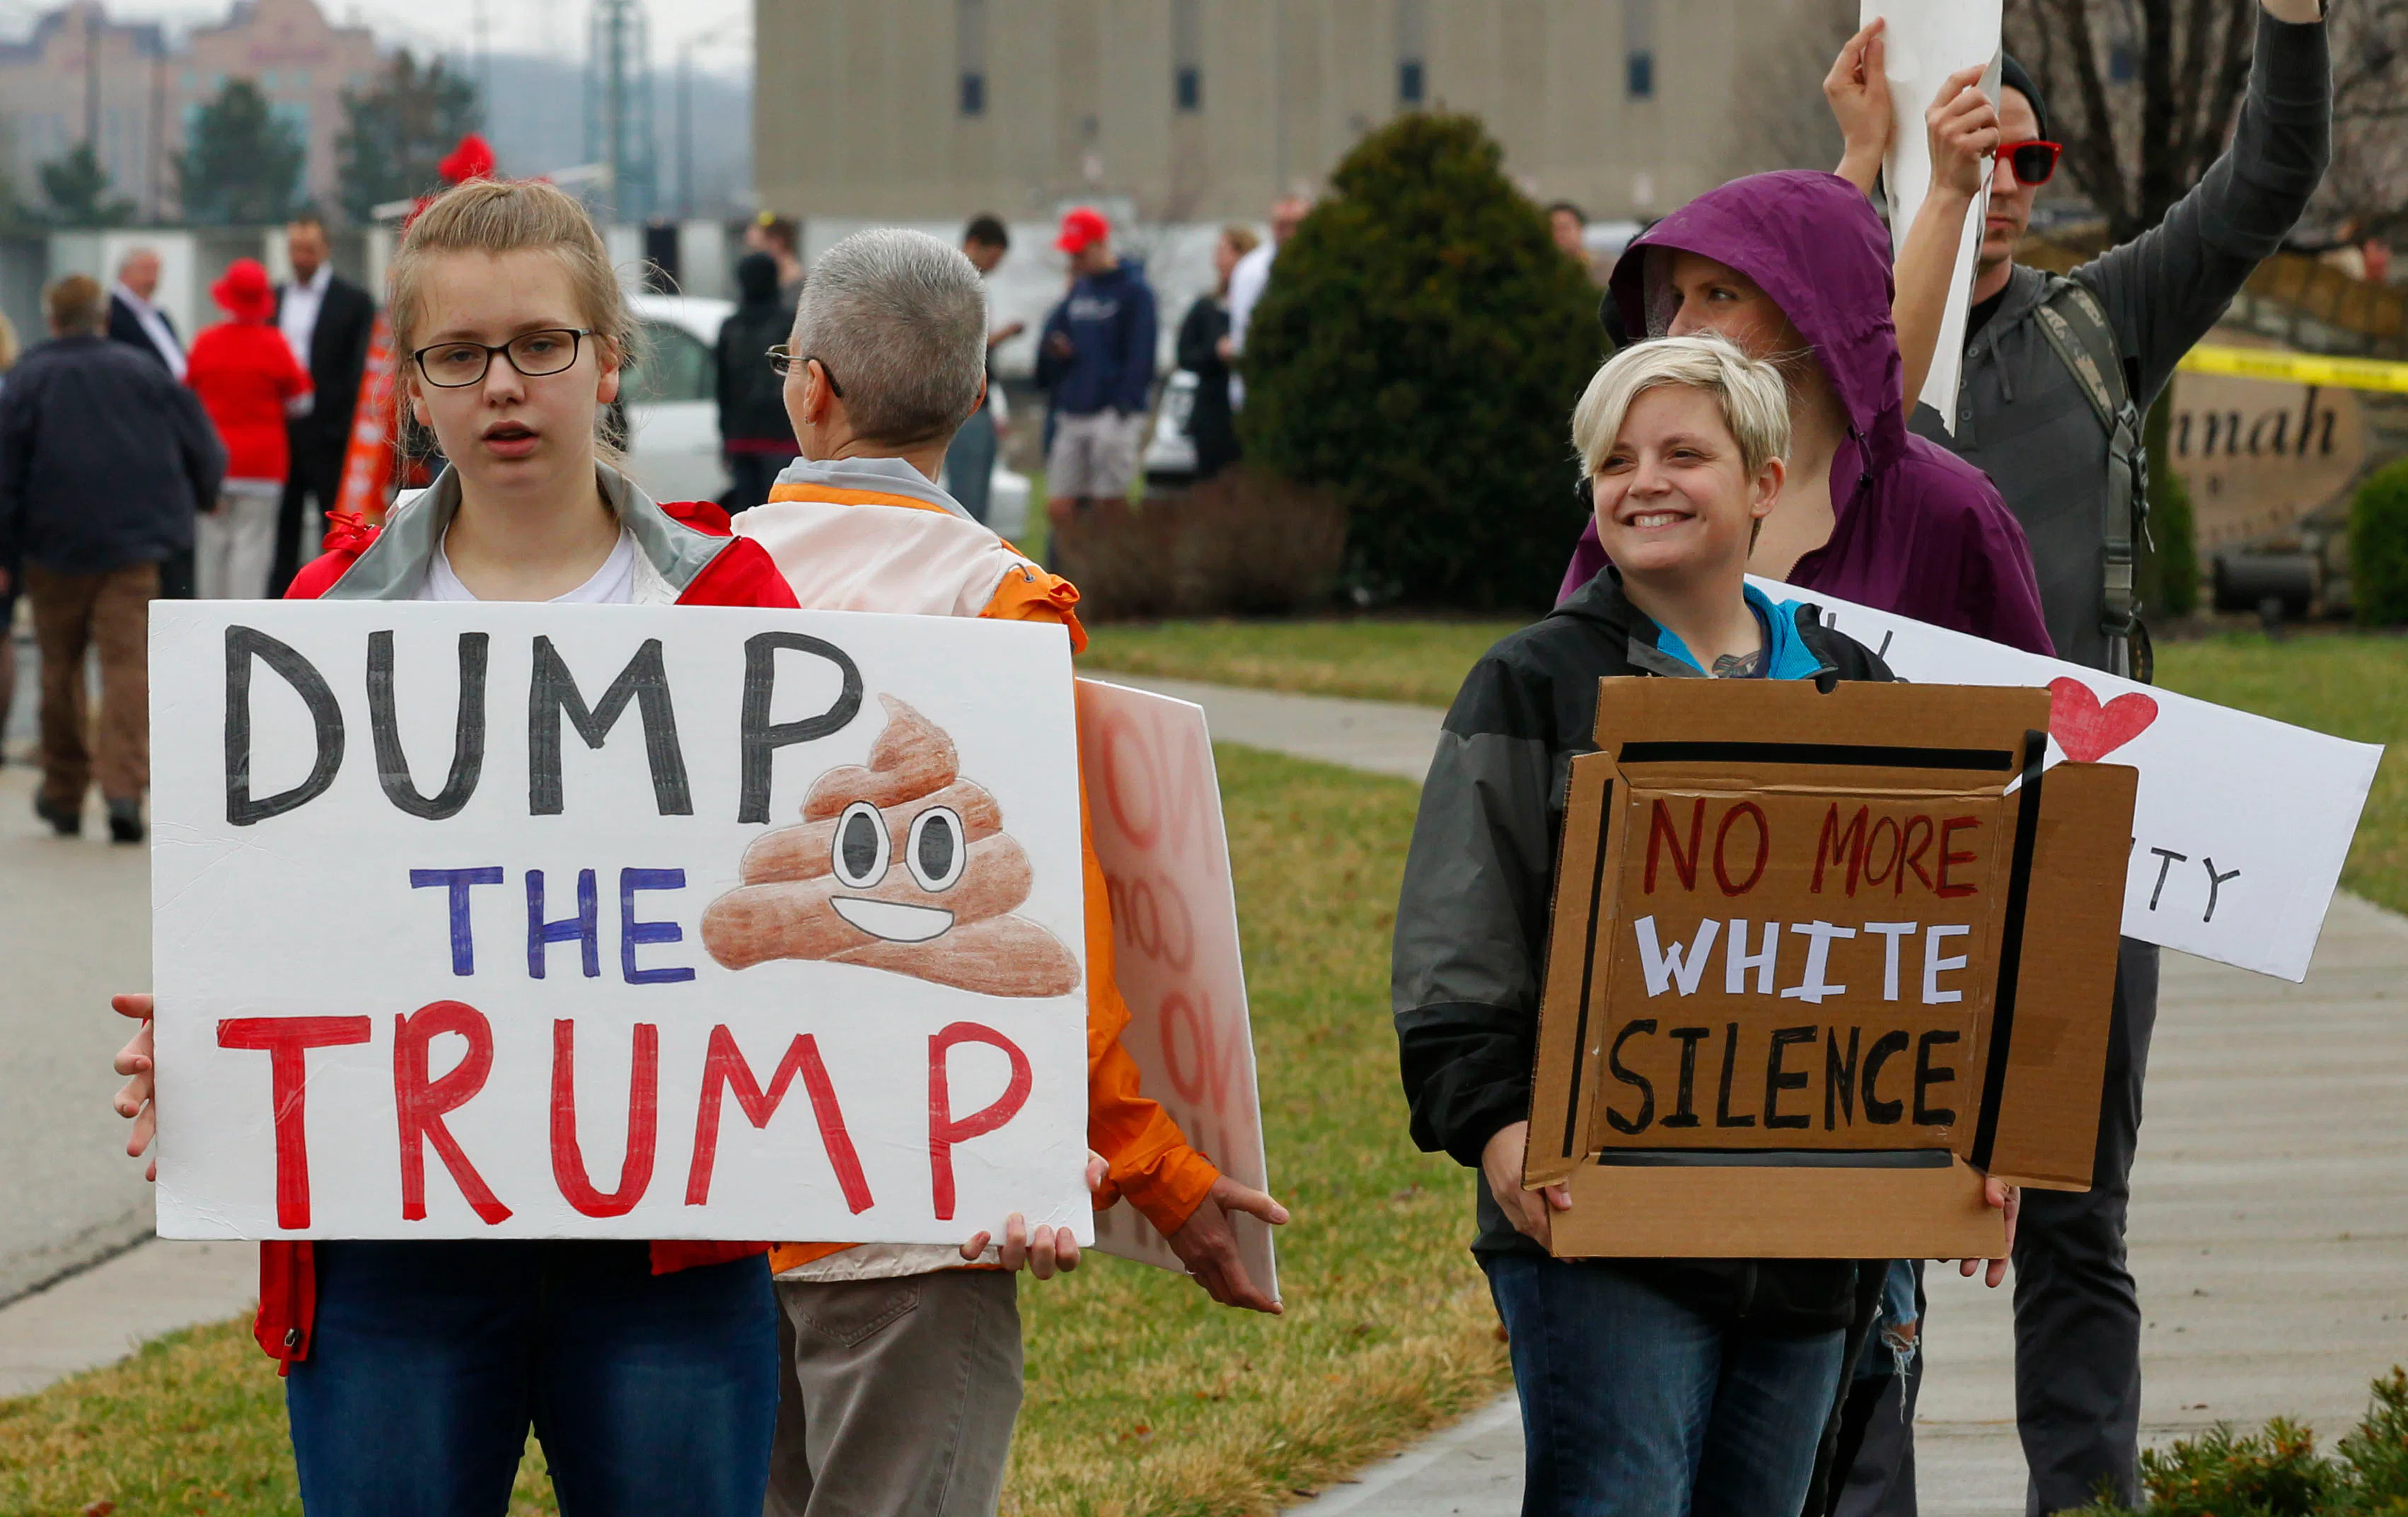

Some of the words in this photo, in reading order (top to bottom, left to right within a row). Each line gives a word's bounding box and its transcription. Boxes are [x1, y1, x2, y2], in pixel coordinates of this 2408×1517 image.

[224, 624, 864, 826] DUMP
[1643, 797, 1770, 897] NO
[1810, 802, 1984, 899] MORE
[2129, 836, 2241, 923] TY
[409, 865, 696, 984] THE
[1633, 913, 1971, 1005] WHITE
[216, 999, 1034, 1230] TRUMP
[1605, 1018, 1962, 1136] SILENCE
